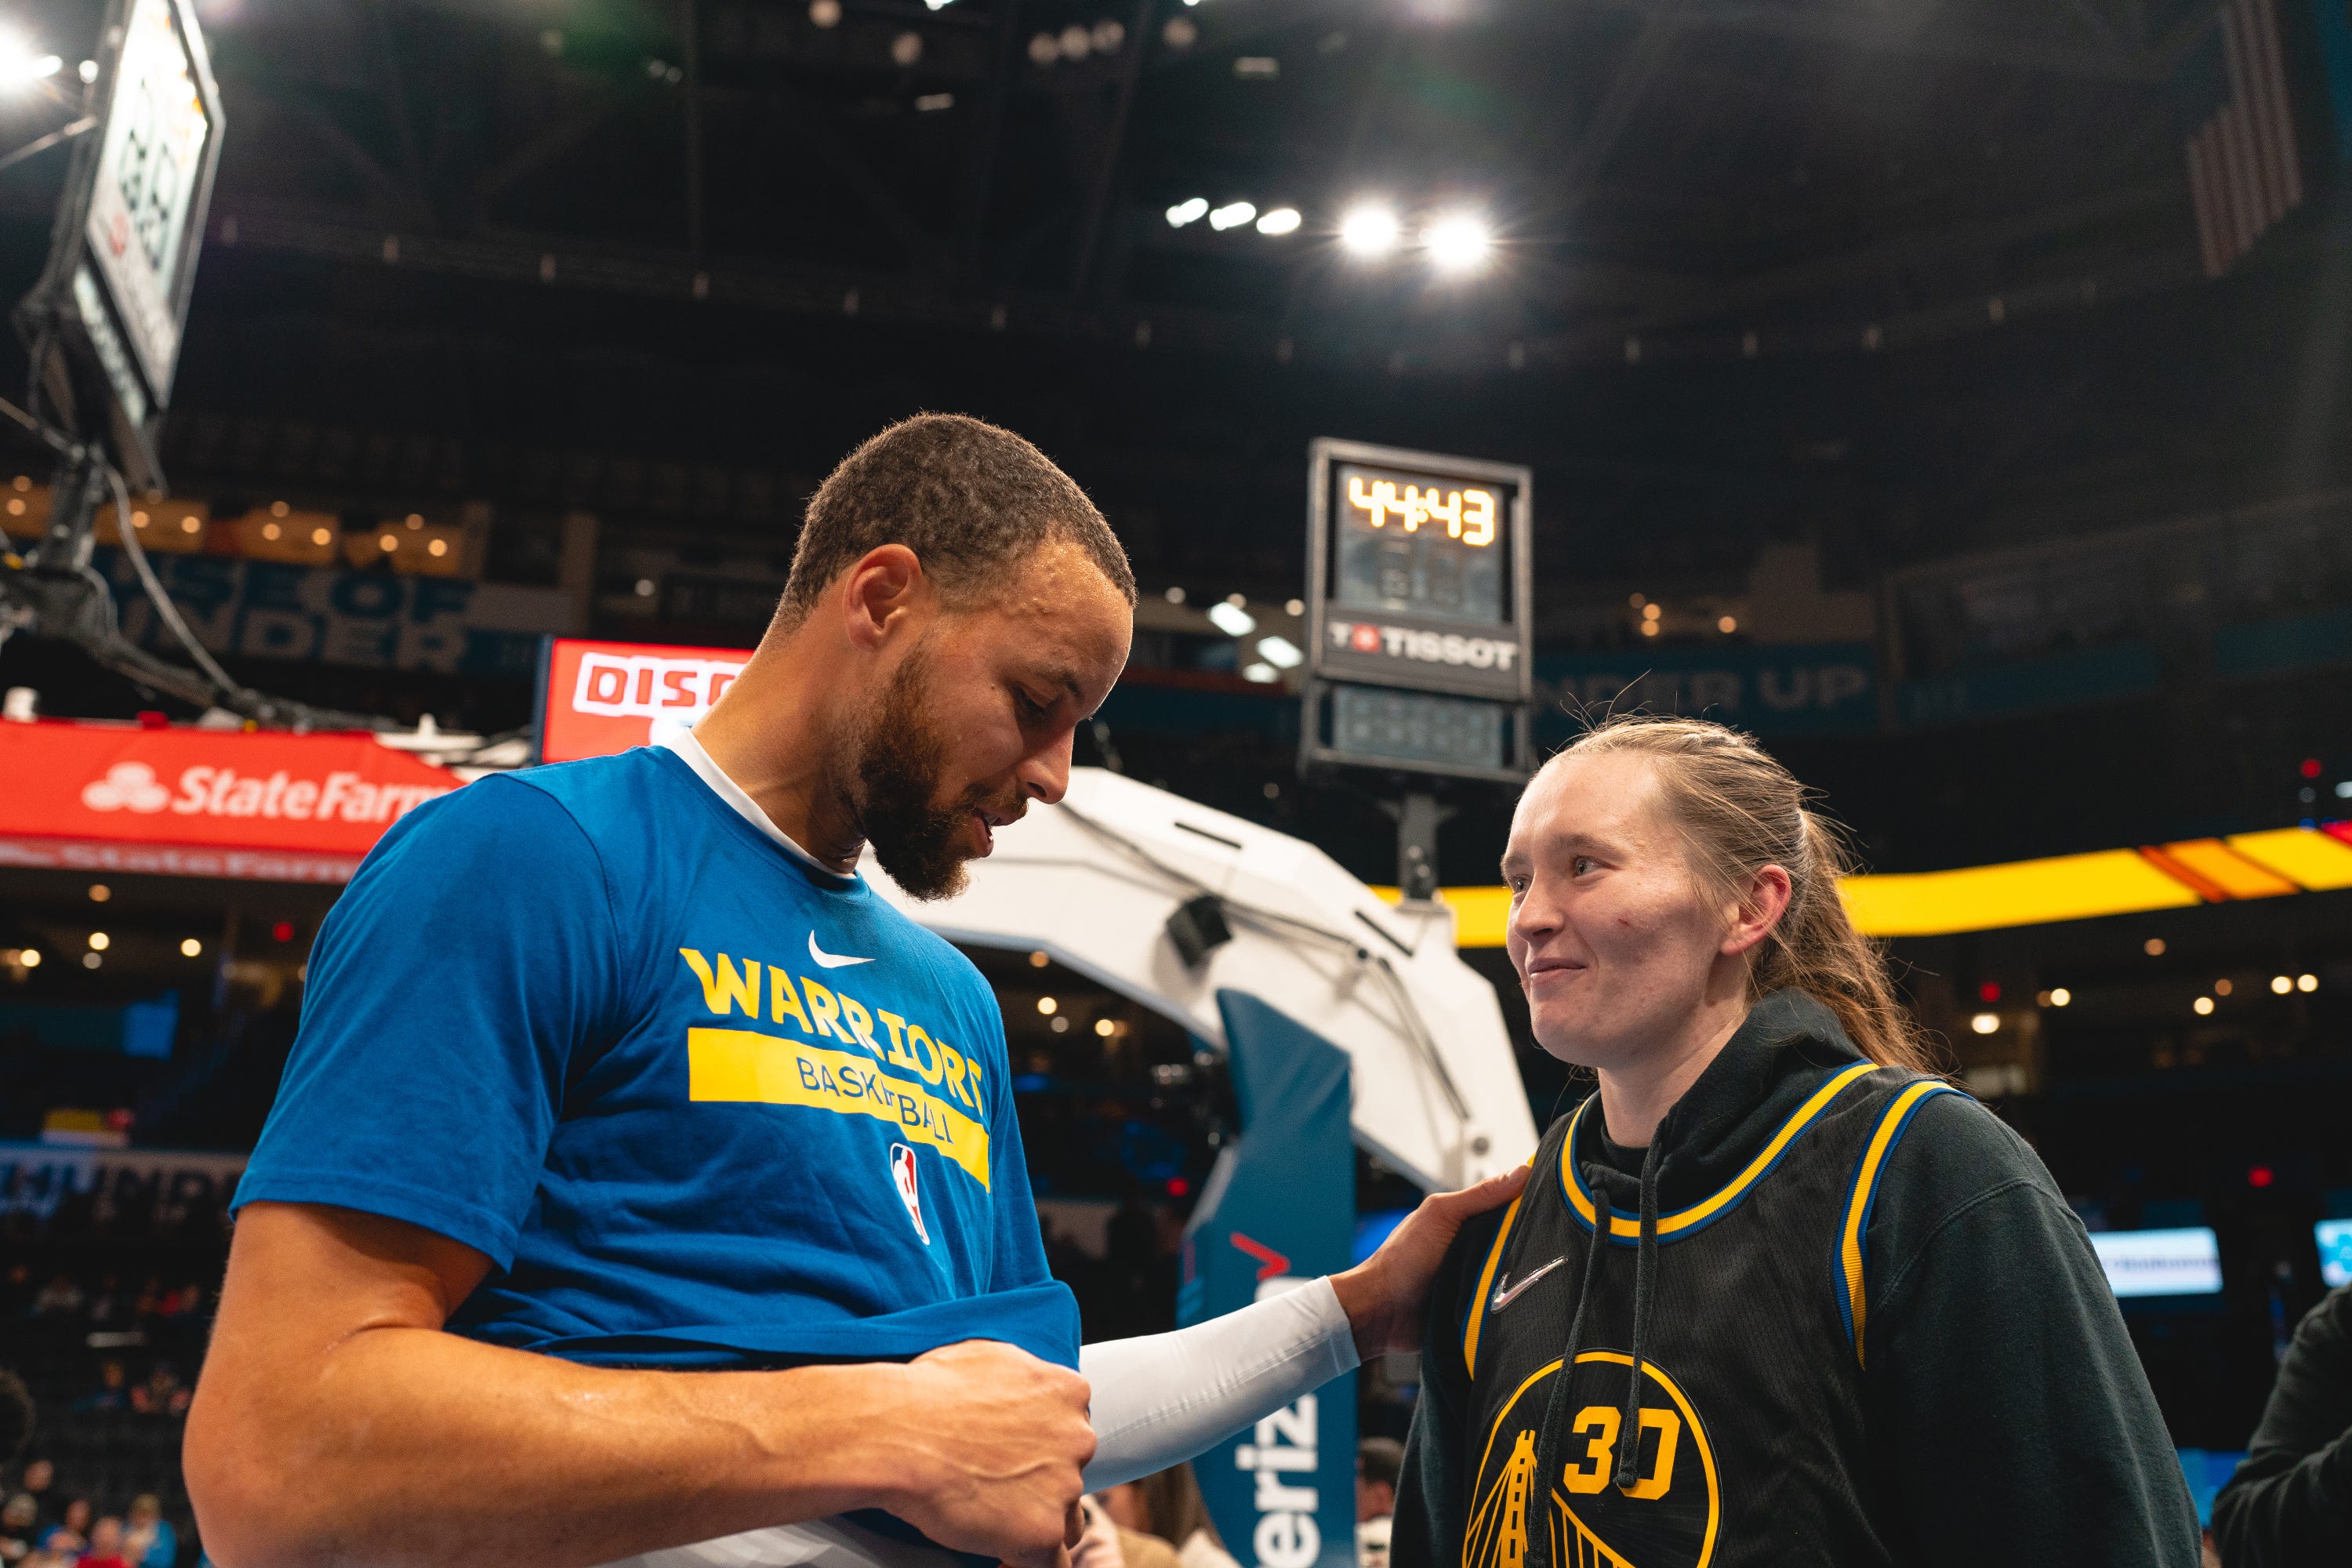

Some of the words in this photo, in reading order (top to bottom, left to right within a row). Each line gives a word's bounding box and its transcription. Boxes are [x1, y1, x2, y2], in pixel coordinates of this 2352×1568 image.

[1348, 476, 1494, 546] 44:43
[90, 546, 308, 612] USE
[332, 572, 475, 626] OF
[1755, 663, 1869, 711] UP
[1234, 1278, 1320, 1568] eriz
[1563, 1406, 1681, 1501] 30
